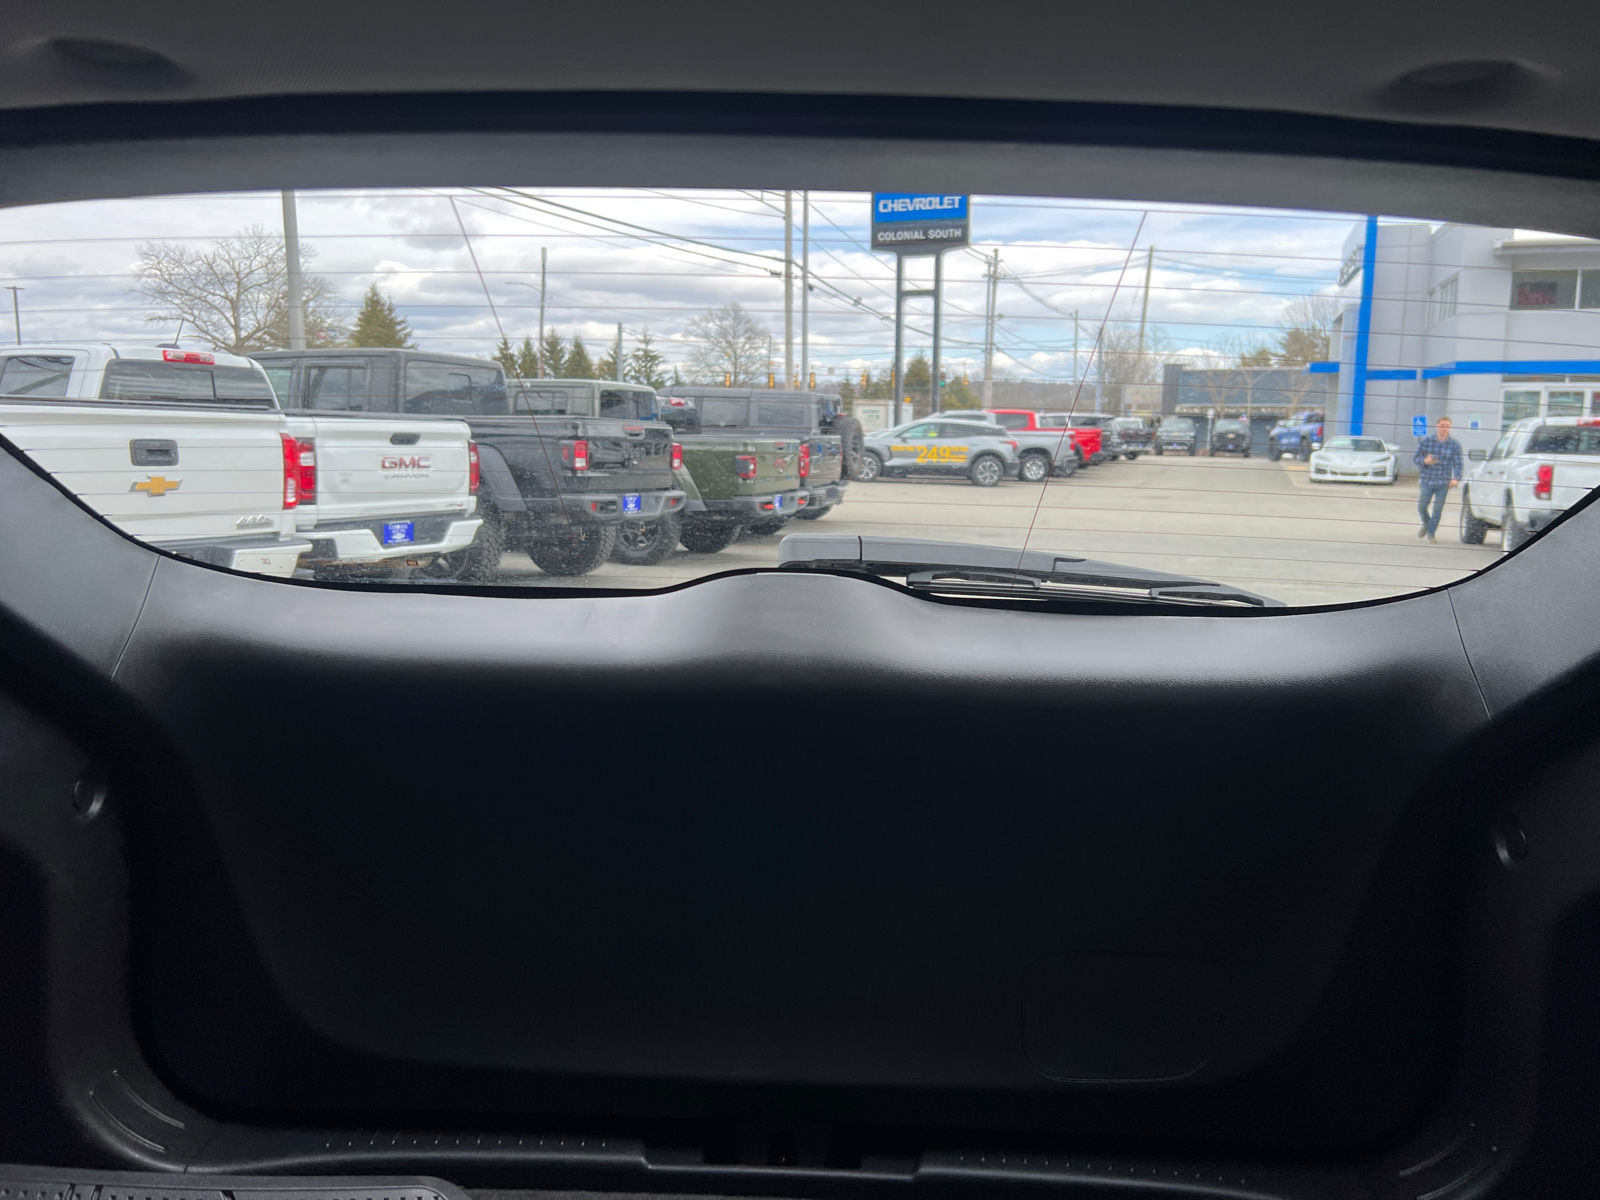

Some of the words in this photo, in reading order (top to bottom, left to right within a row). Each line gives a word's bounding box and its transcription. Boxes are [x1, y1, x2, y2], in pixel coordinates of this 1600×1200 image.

[878, 196, 962, 212] CHEVROLET
[877, 230, 926, 241] COLONIAL
[928, 228, 962, 239] SOUTH
[381, 456, 431, 469] GMC
